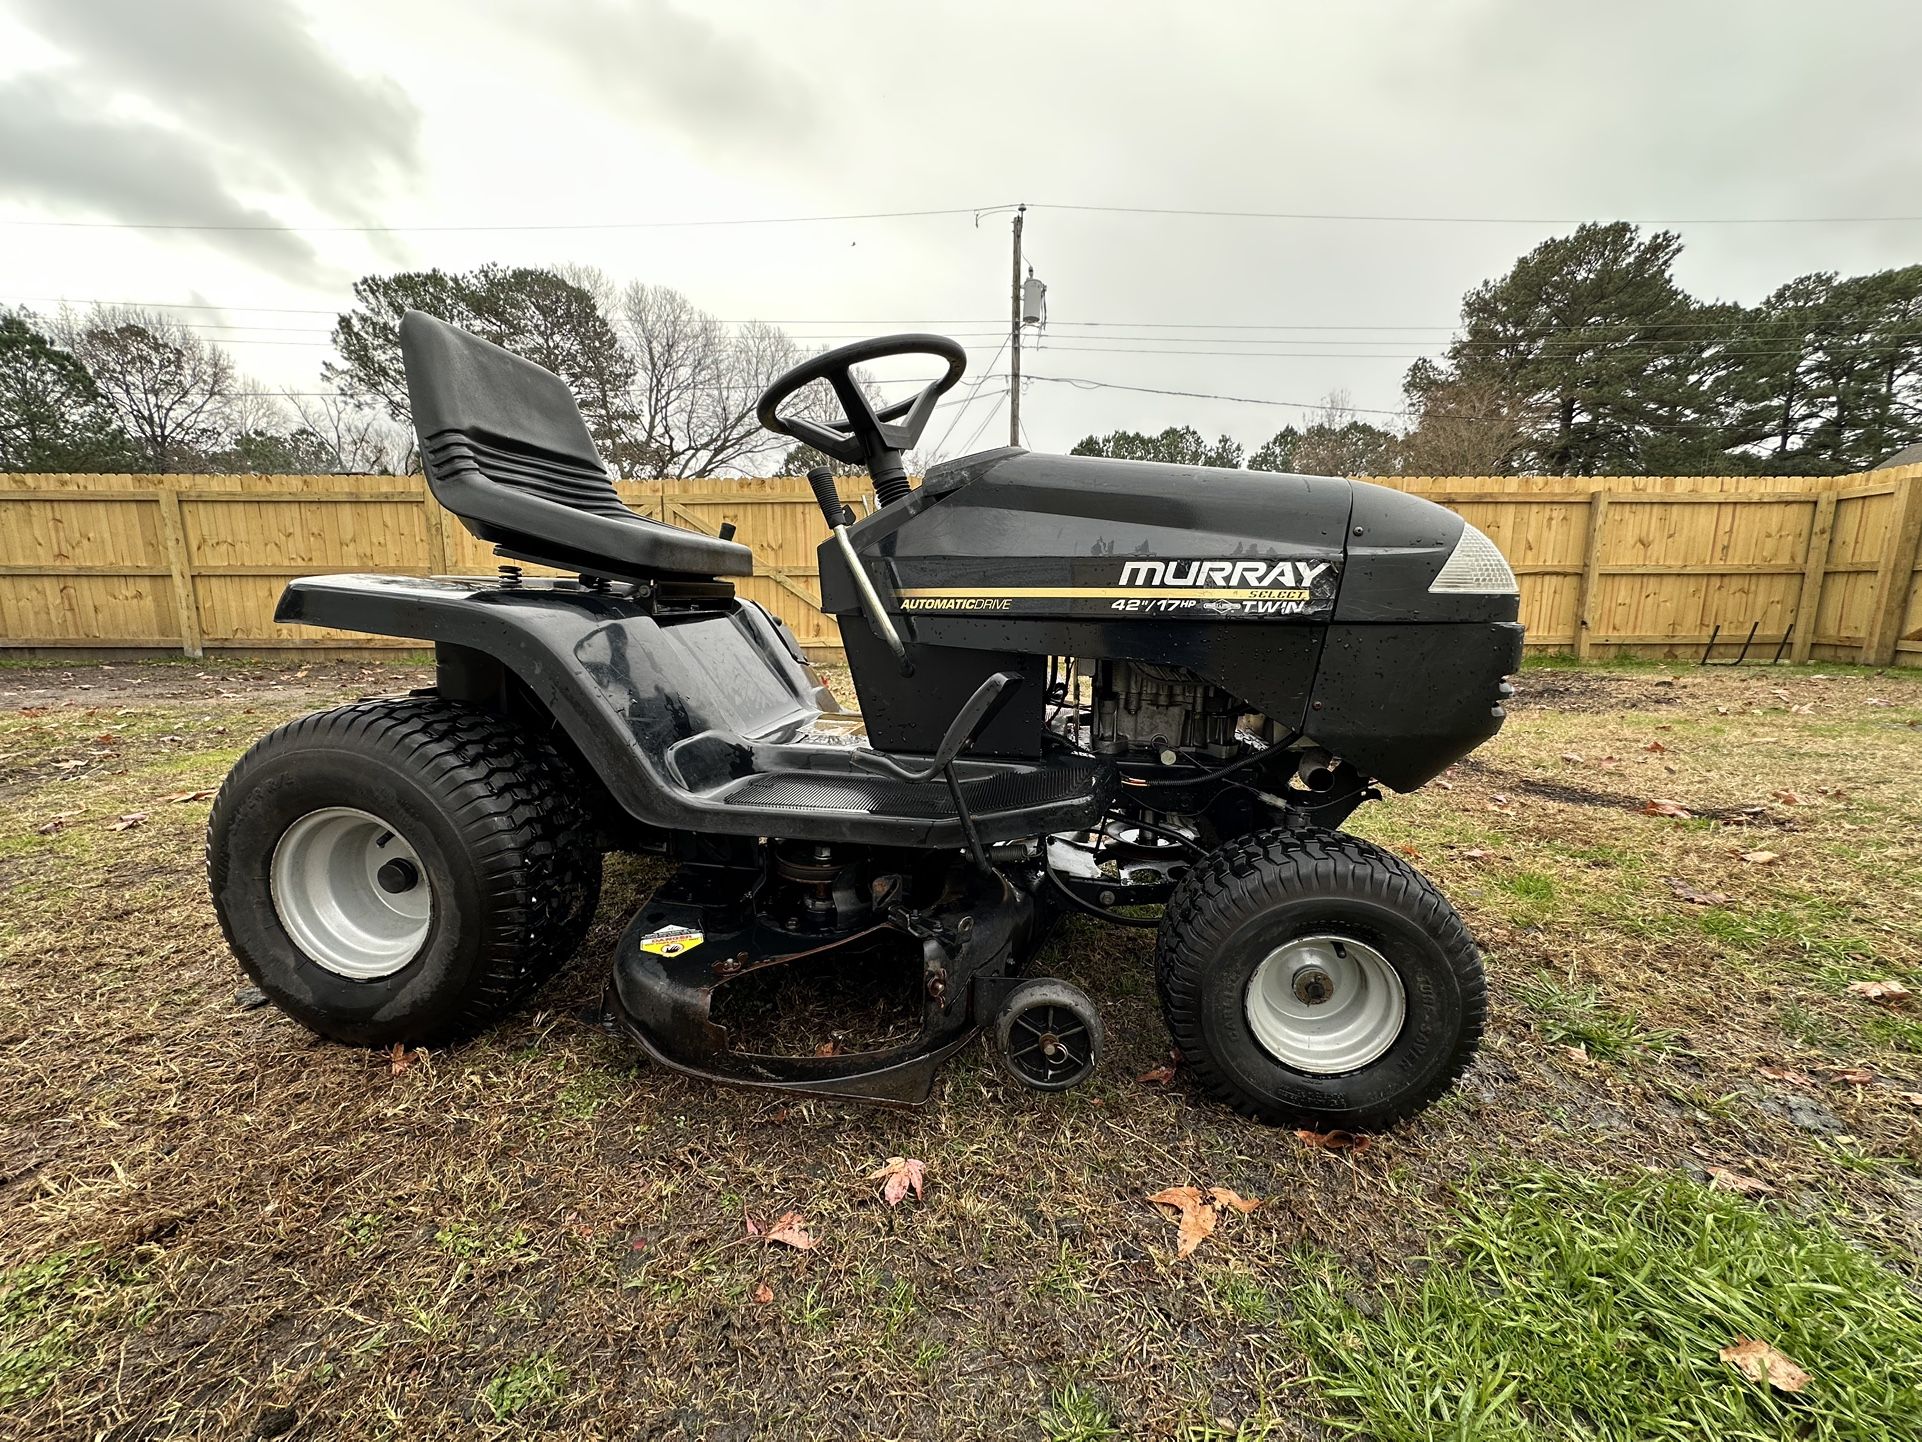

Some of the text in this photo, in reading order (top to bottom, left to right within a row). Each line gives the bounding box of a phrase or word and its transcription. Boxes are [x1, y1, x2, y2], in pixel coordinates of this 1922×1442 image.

[1118, 560, 1331, 587] MURRAY
[1248, 590, 1305, 599] SELECT
[1242, 600, 1305, 614] TWIN
